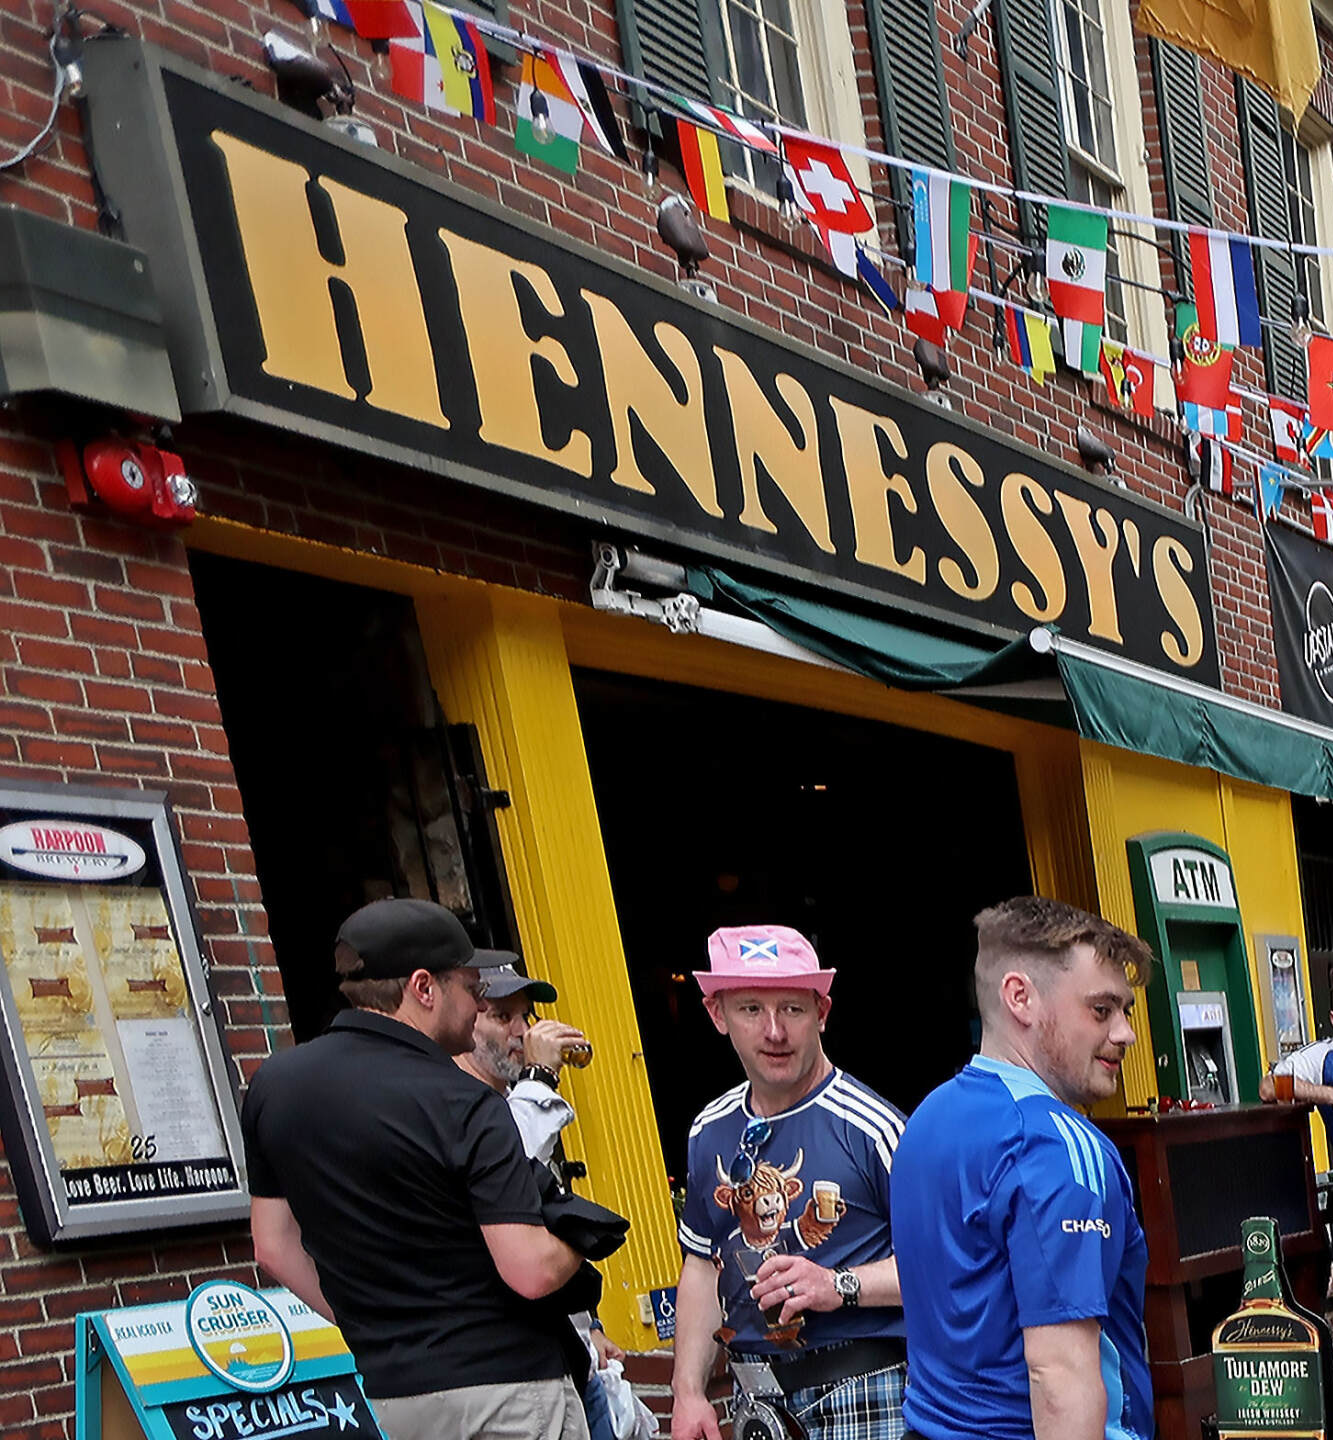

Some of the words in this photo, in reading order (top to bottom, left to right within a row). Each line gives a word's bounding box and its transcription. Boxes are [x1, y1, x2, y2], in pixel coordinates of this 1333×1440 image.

[208, 127, 1205, 669] HENNESSY'S
[31, 827, 106, 853] HARPOON
[36, 854, 109, 866] BREWERY
[1172, 857, 1221, 902] ATM
[130, 1135, 158, 1160] 25
[63, 1173, 92, 1198] Love
[93, 1172, 126, 1195] Beer.
[127, 1170, 156, 1192] Love
[157, 1167, 185, 1189] Life.
[206, 1292, 244, 1312] SUN
[115, 1327, 137, 1341] REAL
[137, 1323, 157, 1337] ICED
[157, 1321, 174, 1335] TEA
[197, 1309, 270, 1333] CRUISER
[1223, 1356, 1309, 1379] TULLAMORE
[1250, 1378, 1284, 1397] DEW
[186, 1388, 328, 1440] SPECIALS
